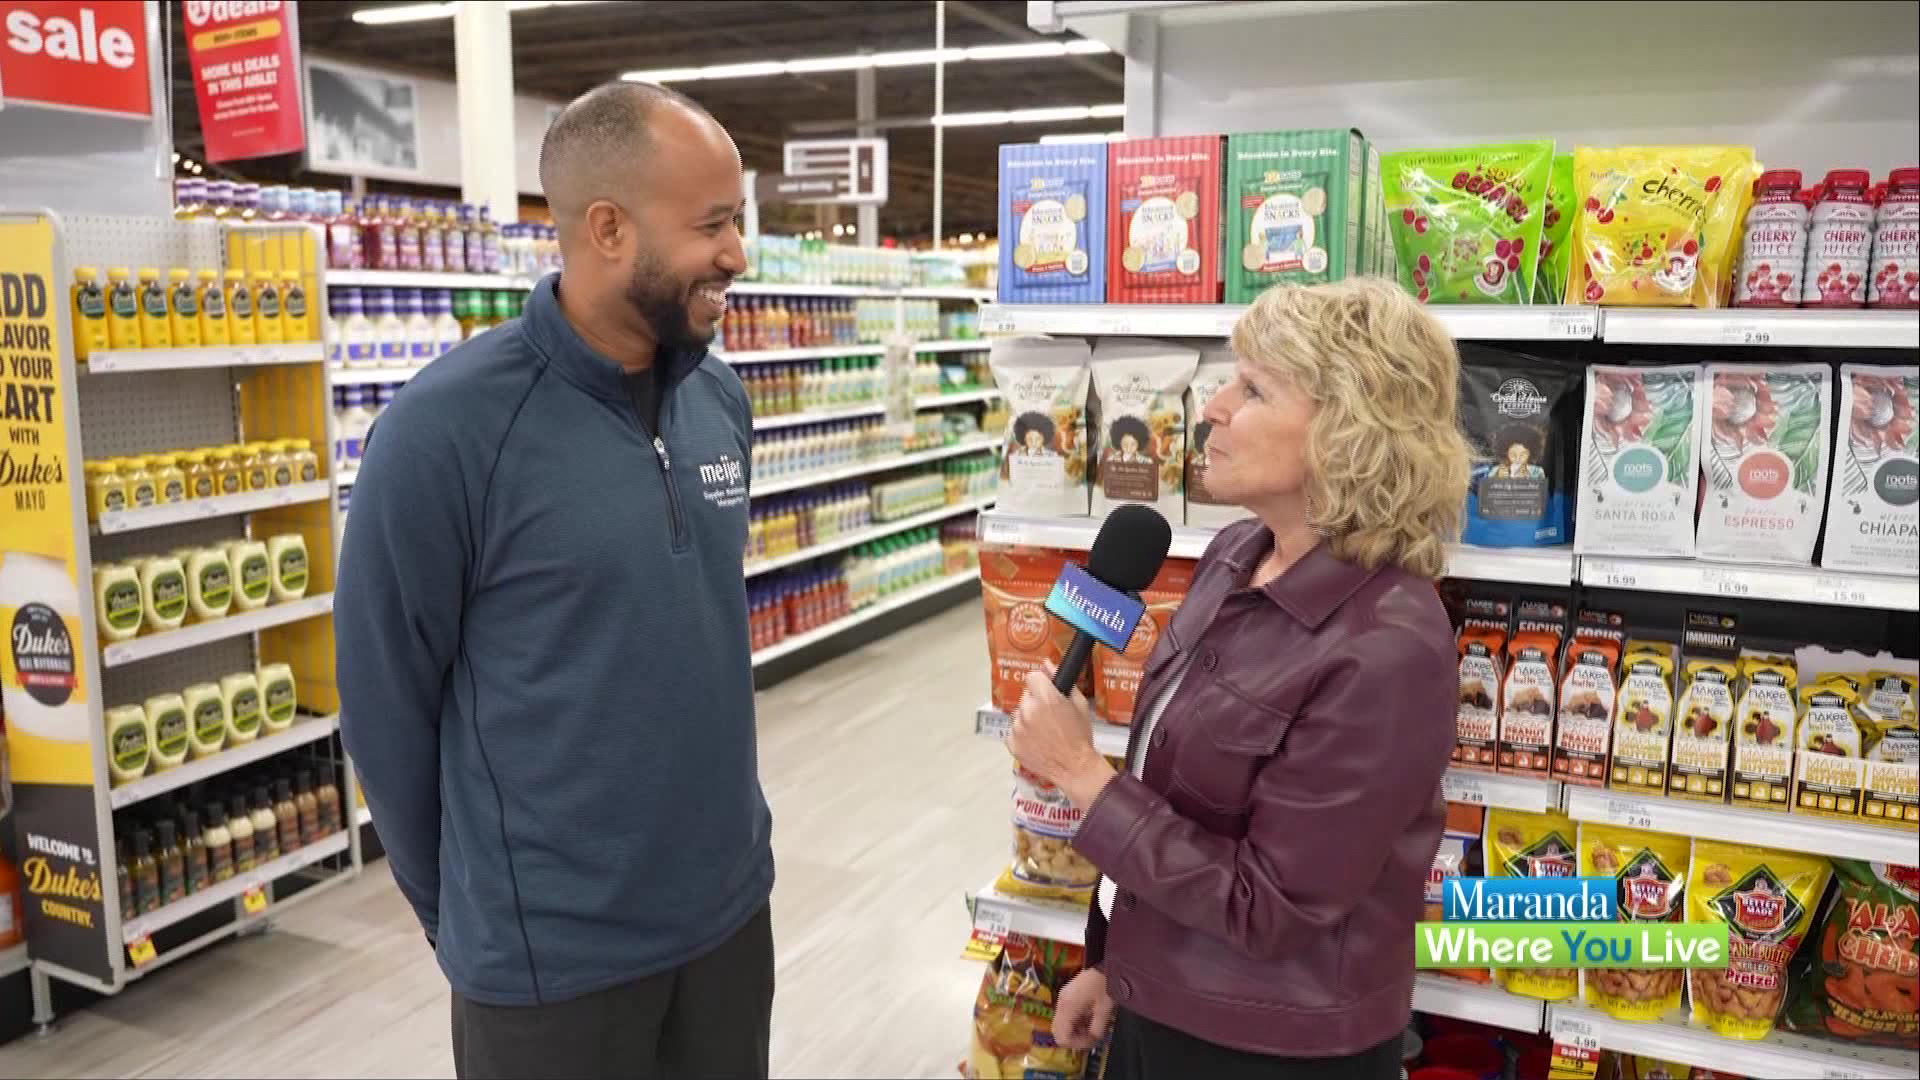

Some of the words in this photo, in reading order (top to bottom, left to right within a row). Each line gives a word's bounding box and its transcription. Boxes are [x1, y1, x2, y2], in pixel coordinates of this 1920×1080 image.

[6, 8, 135, 69] sale
[244, 54, 280, 72] DEALS
[1751, 231, 1797, 243] CHERRY
[1824, 231, 1866, 243] CHERRY
[1751, 243, 1793, 256] JUICE
[1824, 243, 1863, 256] JUICE
[0, 272, 47, 319] DD
[1566, 325, 1593, 335] 11.99
[0, 323, 51, 352] AVOR
[1745, 332, 1770, 344] 2.99
[10, 356, 54, 380] YOUR
[0, 383, 56, 424] ART
[9, 427, 40, 446] WITH
[699, 454, 741, 485] meijer
[1624, 462, 1653, 474] roots
[1886, 474, 1918, 485] roots
[15, 490, 46, 512] MAYO
[1594, 509, 1637, 521] SANTA
[1641, 510, 1676, 522] ROSA
[1723, 515, 1794, 530] ESPRESSO
[1606, 575, 1636, 586] 15.99
[1717, 582, 1749, 594] 15.99
[1833, 590, 1866, 602] 15.99
[1062, 579, 1126, 634] Maranda
[13, 623, 70, 657] Duke's
[1686, 630, 1736, 648] IMMUNITY
[1505, 727, 1545, 736] PEANUT
[1561, 732, 1602, 743] PEANUT
[1561, 740, 1601, 753] BUTTER
[1462, 791, 1484, 802] 2.49
[1016, 799, 1047, 817] PORK
[1628, 815, 1651, 827] 2.49
[27, 832, 81, 862] WELCOME
[24, 856, 101, 901] Duke's
[1742, 898, 1778, 911] BETTER
[41, 899, 95, 929] COUNTRY.
[1746, 907, 1773, 917] MADE
[1759, 943, 1791, 963] BUTTER
[1742, 960, 1769, 973] FILLED
[1727, 967, 1778, 990] Pretzel
[1574, 1035, 1597, 1049] 4.99
